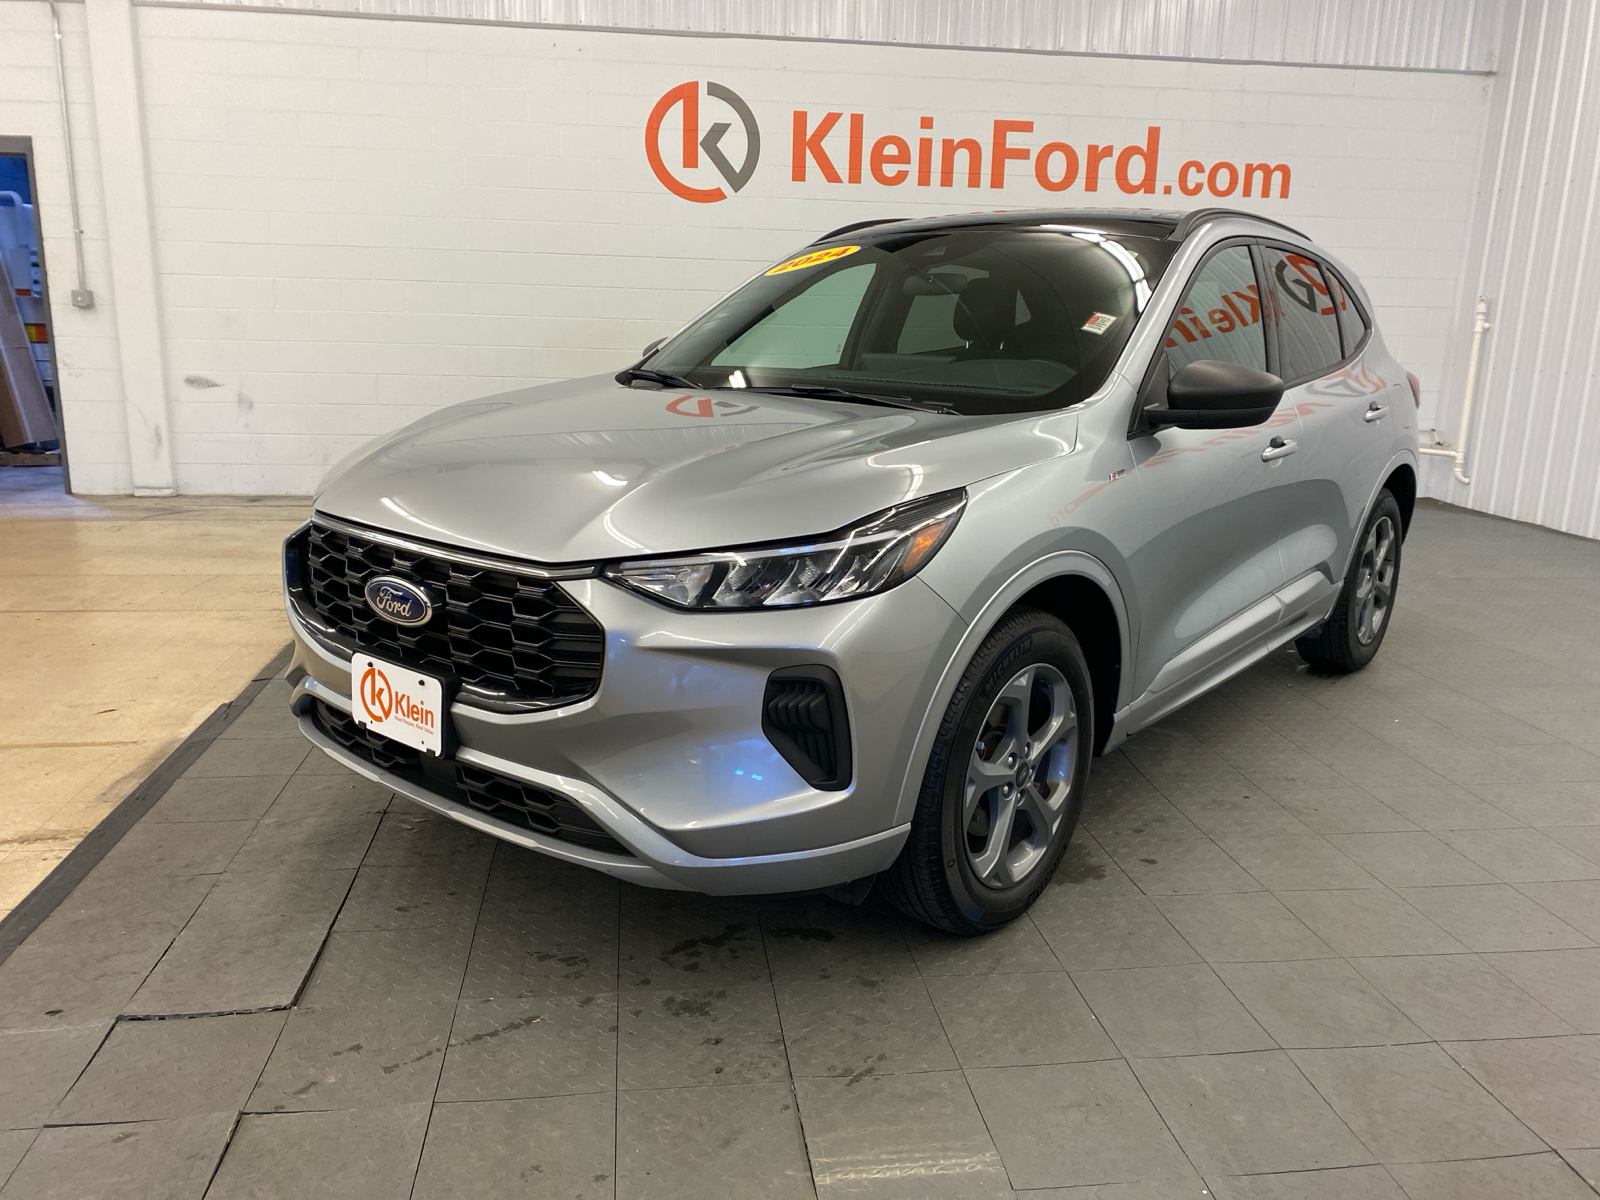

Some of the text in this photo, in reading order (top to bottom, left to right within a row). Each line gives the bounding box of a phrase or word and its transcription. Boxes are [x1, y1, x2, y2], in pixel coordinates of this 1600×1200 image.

[790, 110, 1292, 199] KleinFord.com
[772, 247, 852, 273] 2024
[376, 586, 412, 617] Ford
[984, 638, 1032, 697] MICHELIN
[394, 690, 434, 729] Klein
